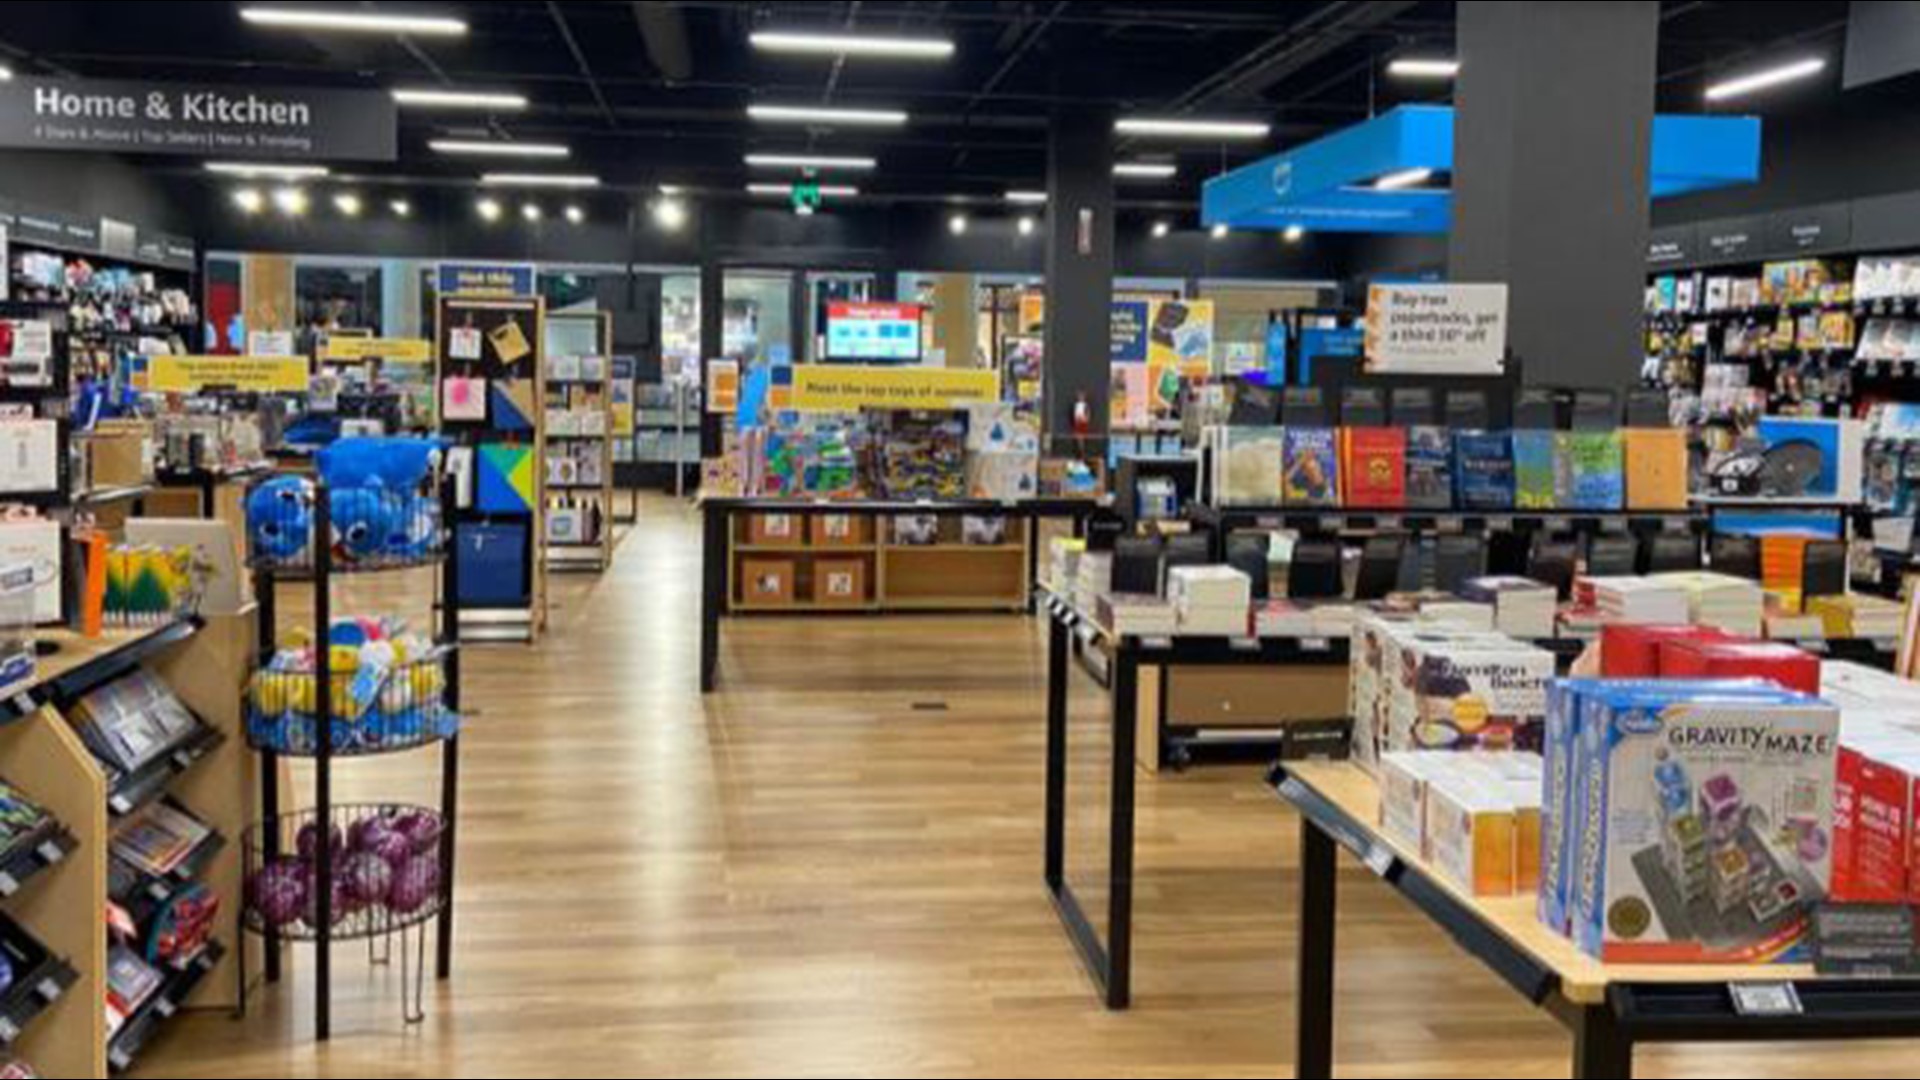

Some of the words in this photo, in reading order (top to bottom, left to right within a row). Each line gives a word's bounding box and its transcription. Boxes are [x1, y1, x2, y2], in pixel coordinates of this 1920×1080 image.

[35, 87, 136, 118] Home
[146, 92, 171, 120] &
[183, 94, 310, 124] Kitchen
[1668, 726, 1765, 749] GRAVITY
[1766, 734, 1829, 754] MAZE
